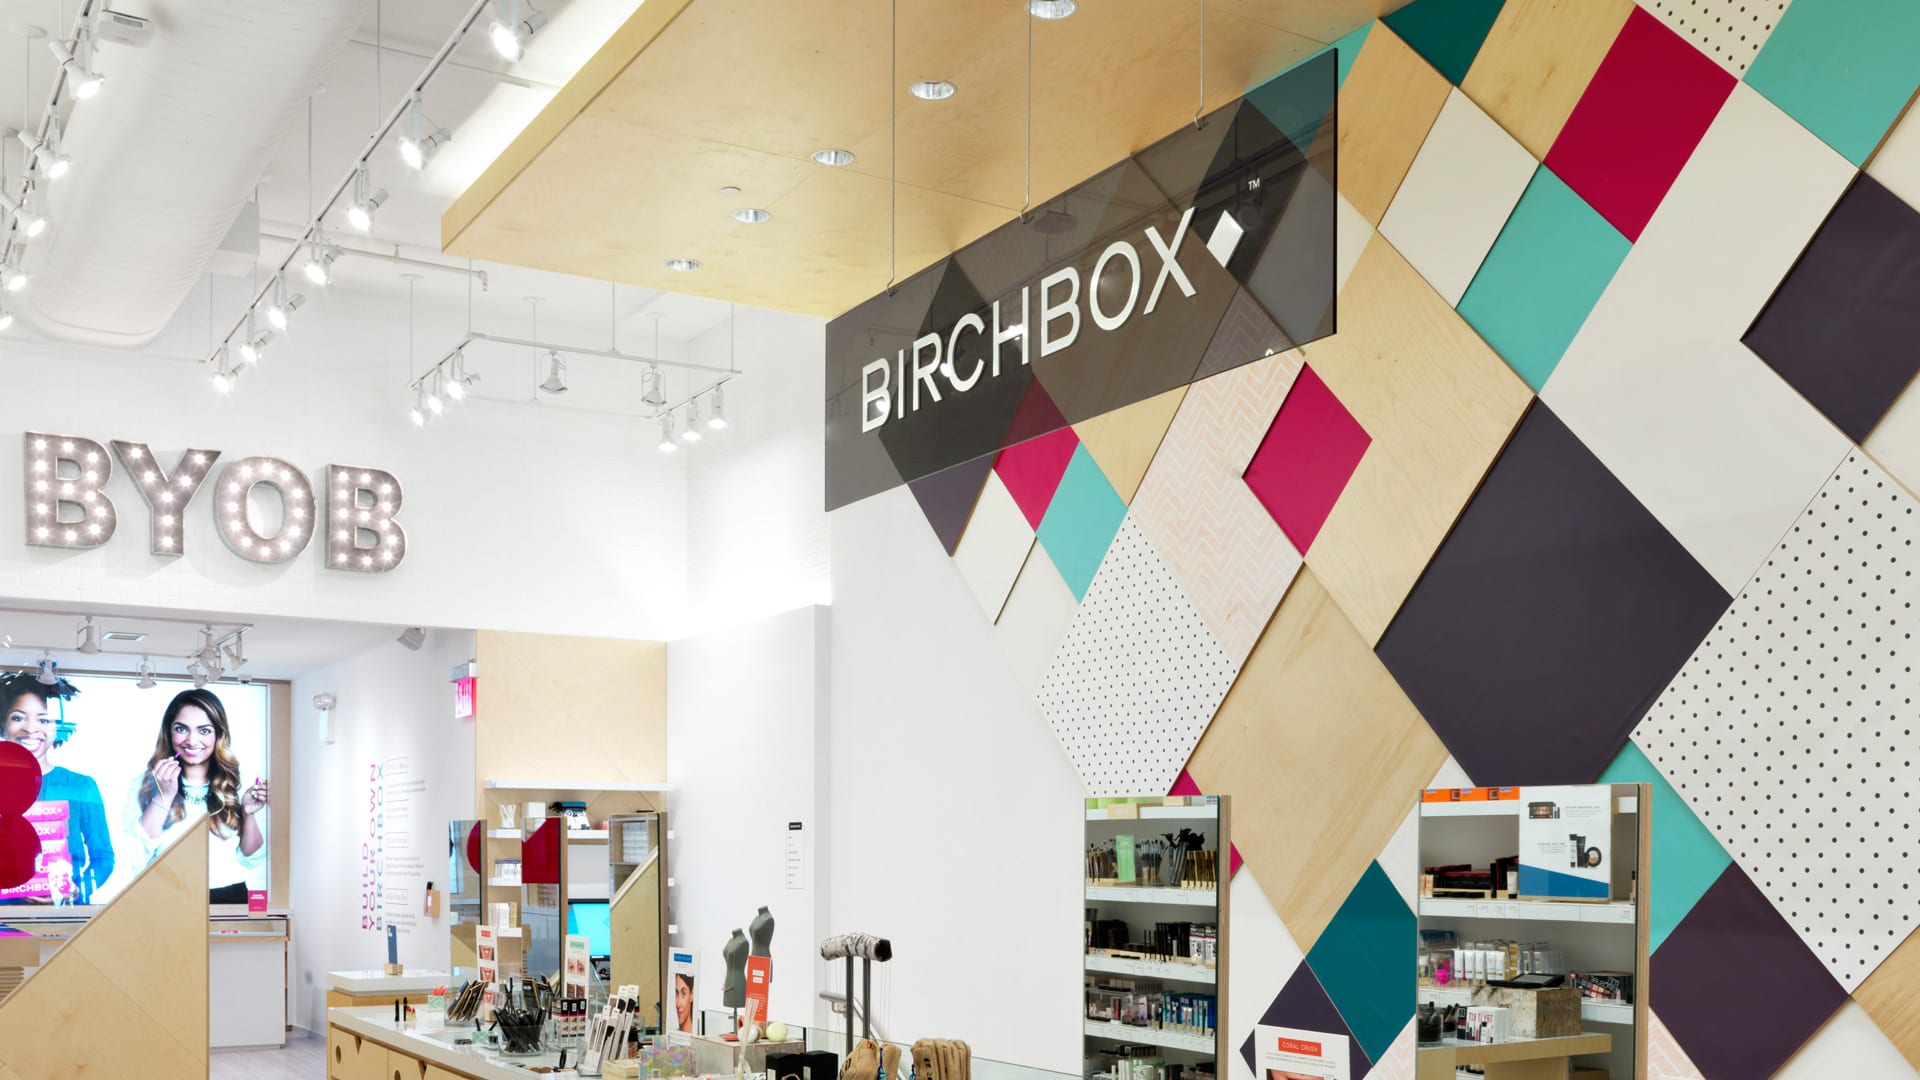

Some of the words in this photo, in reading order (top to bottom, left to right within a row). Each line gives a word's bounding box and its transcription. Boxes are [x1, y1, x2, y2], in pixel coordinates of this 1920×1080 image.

[862, 206, 1199, 434] BIRCHBOX
[25, 431, 408, 573] BYOB
[1, 883, 50, 895] BIRCHBO
[361, 842, 369, 930] BUILD
[376, 763, 384, 931] BIRCHBOX
[1281, 1041, 1299, 1050] CORAL
[1300, 1043, 1318, 1052] CRUSH
